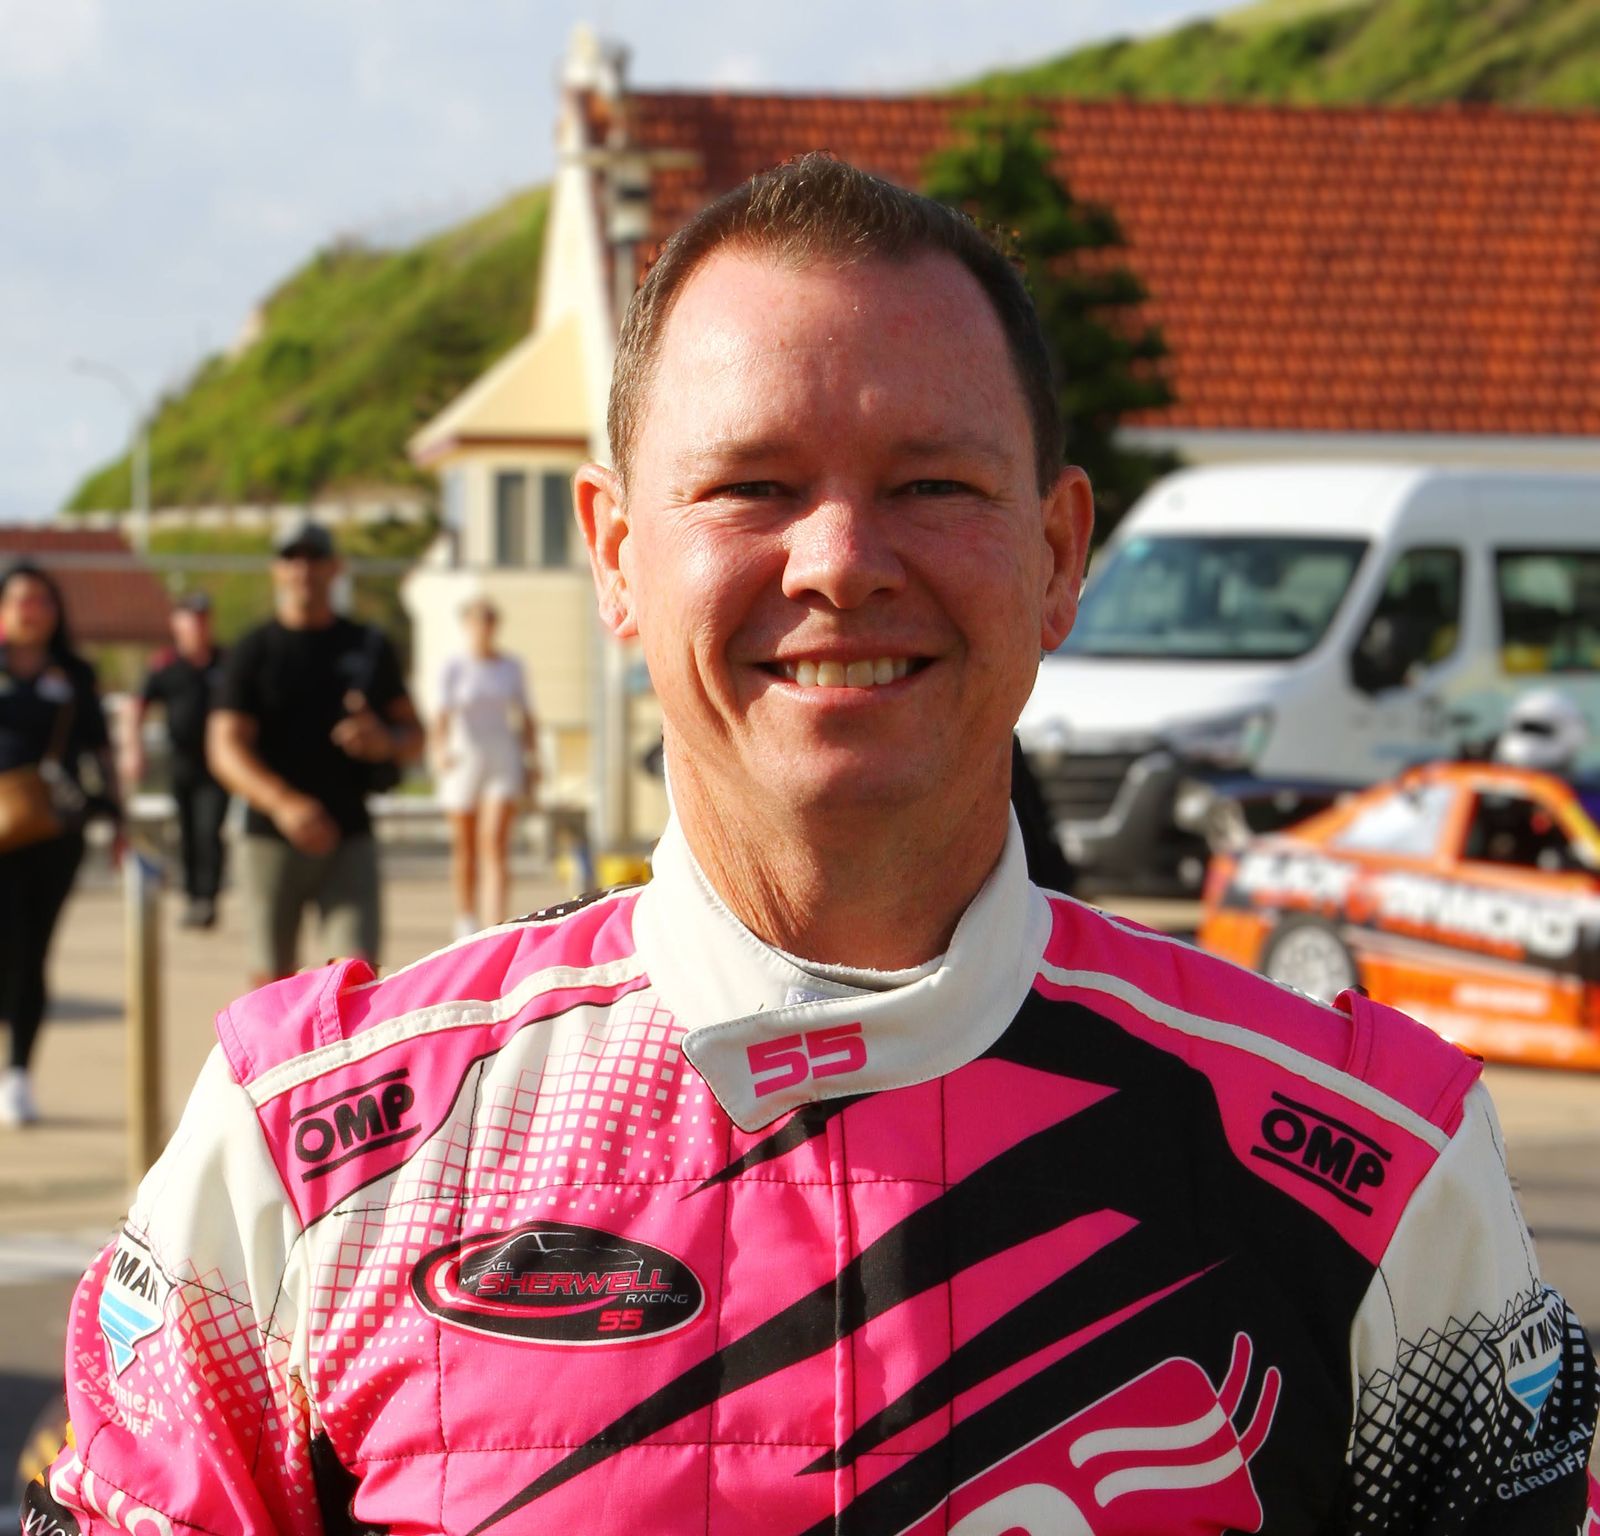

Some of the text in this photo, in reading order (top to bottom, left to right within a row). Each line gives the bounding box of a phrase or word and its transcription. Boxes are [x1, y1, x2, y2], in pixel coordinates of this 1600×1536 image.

[747, 1022, 867, 1098] 55
[295, 1083, 414, 1163] OMP
[1261, 1108, 1385, 1194] OMP
[475, 1268, 673, 1296] SHERWELL
[625, 1293, 689, 1304] RACING
[597, 1308, 644, 1331] 55
[75, 1378, 154, 1438] CARDIFF
[1496, 1449, 1586, 1500] CARDIFF
